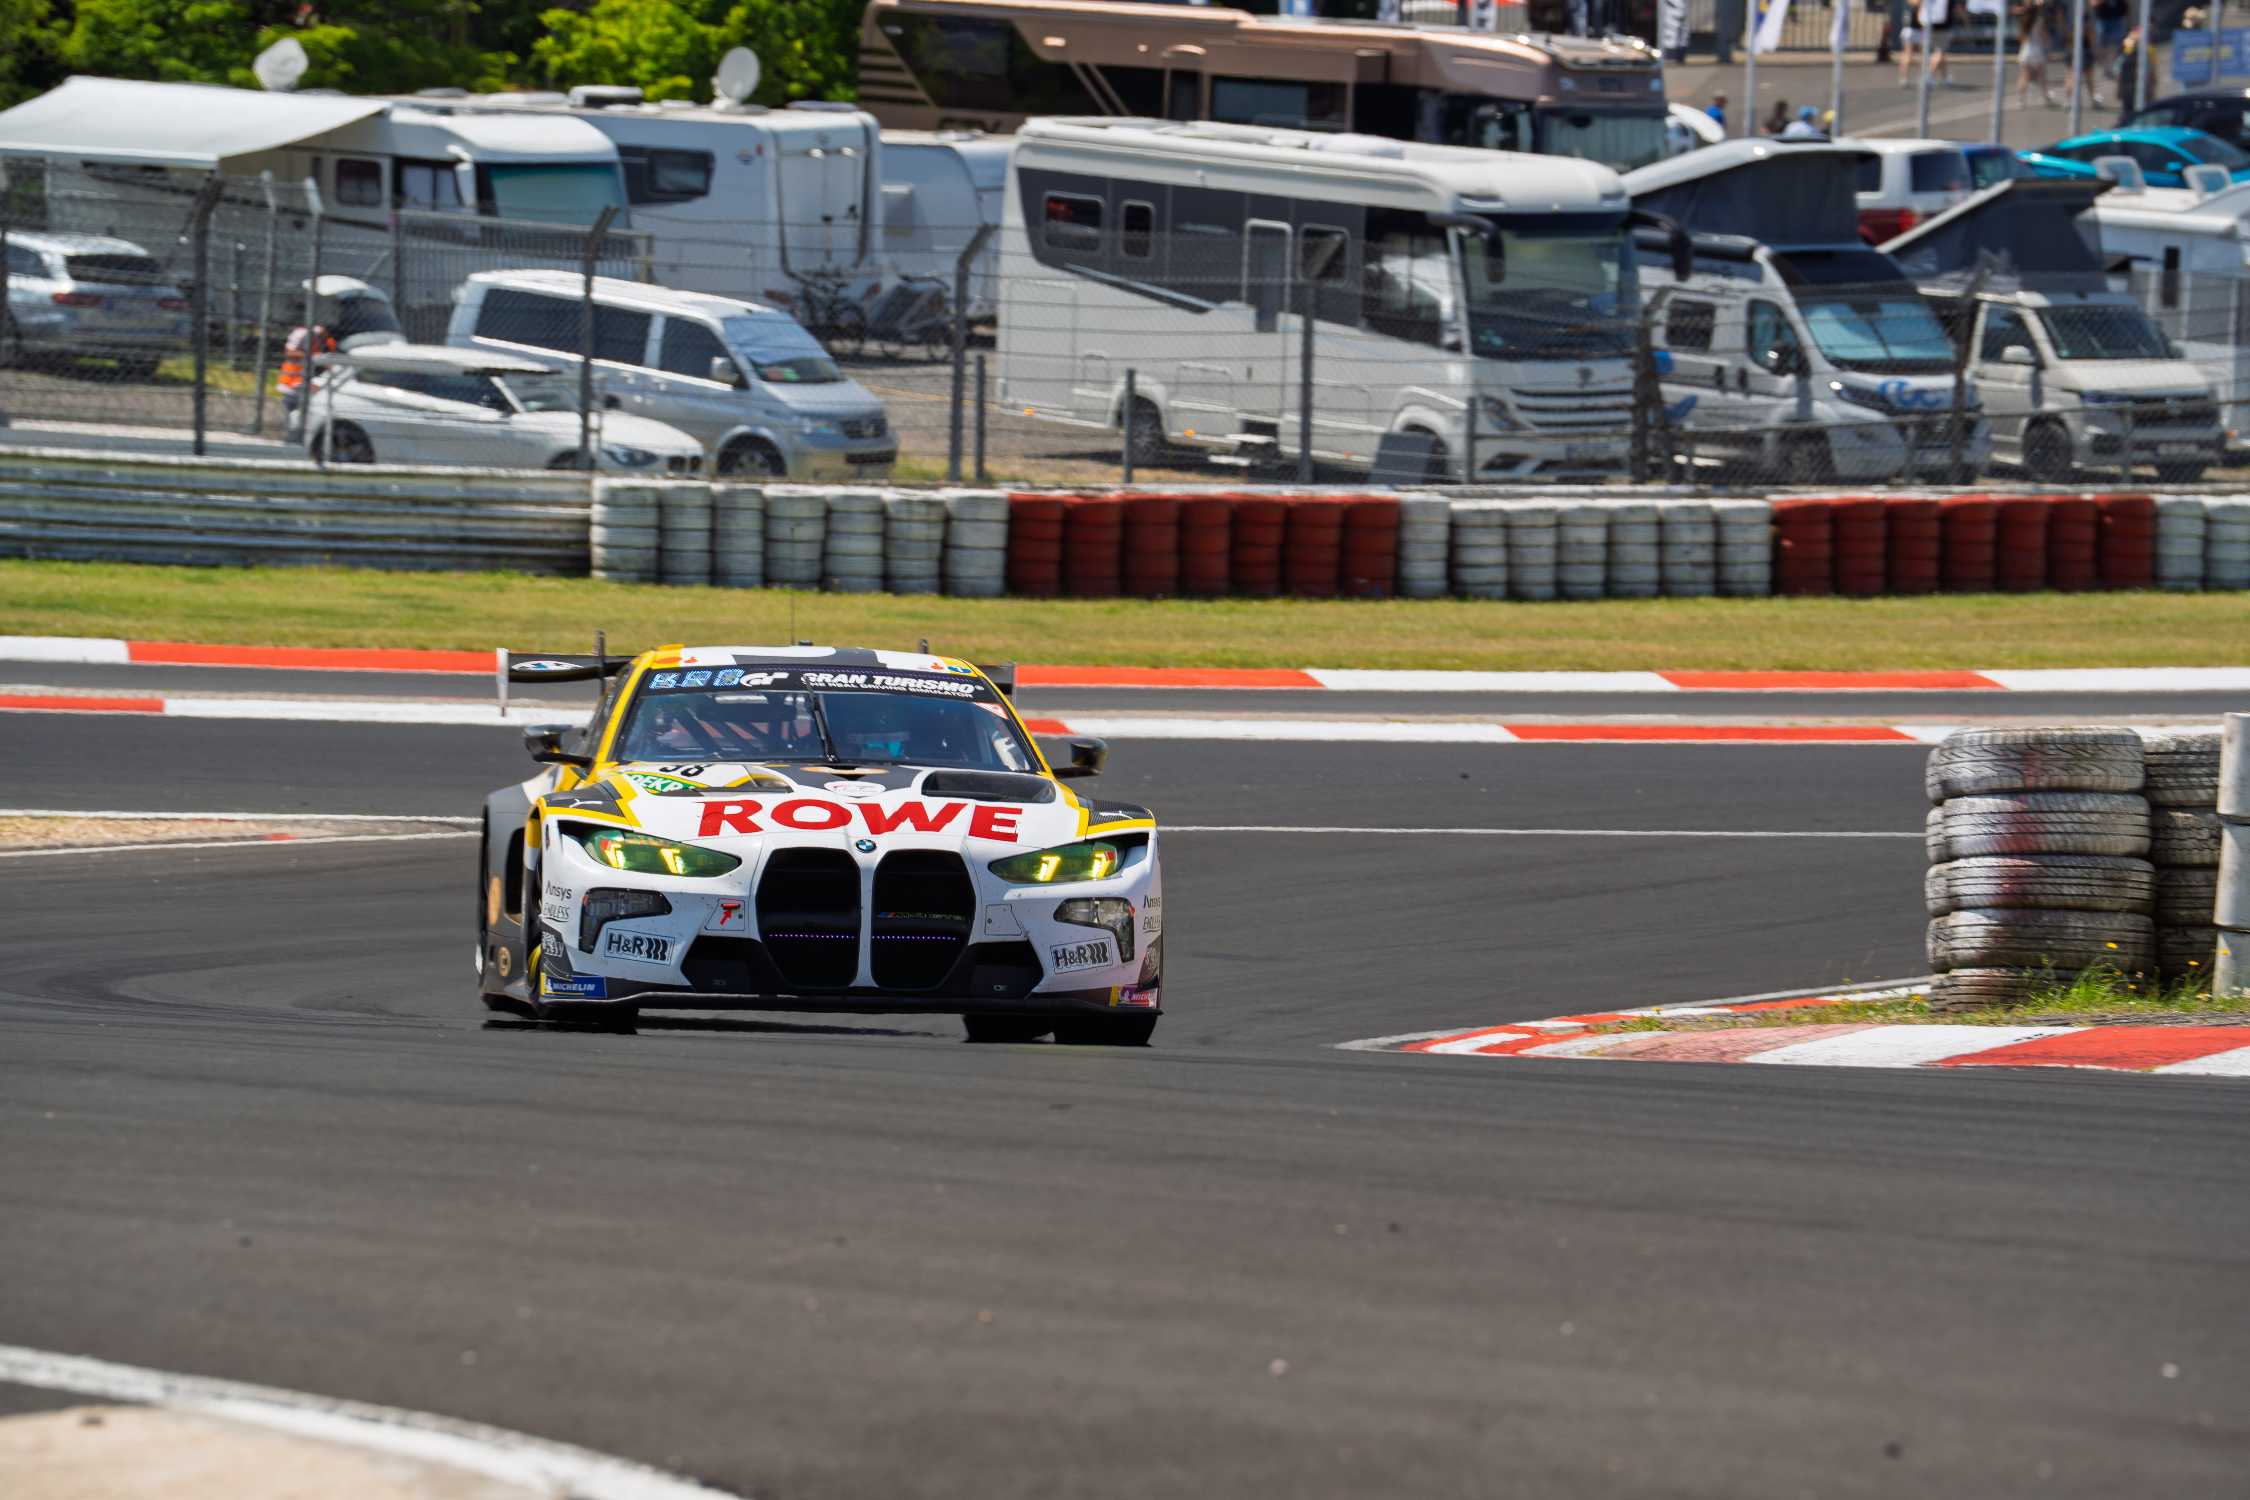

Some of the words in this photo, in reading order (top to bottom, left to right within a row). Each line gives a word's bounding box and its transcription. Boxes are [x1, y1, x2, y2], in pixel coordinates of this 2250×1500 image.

[801, 673, 867, 685] GRAN
[873, 676, 974, 694] TURISMO
[626, 773, 696, 792] DEKR
[697, 799, 1023, 842] ROWE
[545, 880, 572, 900] Ansys
[607, 933, 643, 955] H&R
[1054, 945, 1088, 967] H&R
[552, 981, 596, 992] MICHELIN
